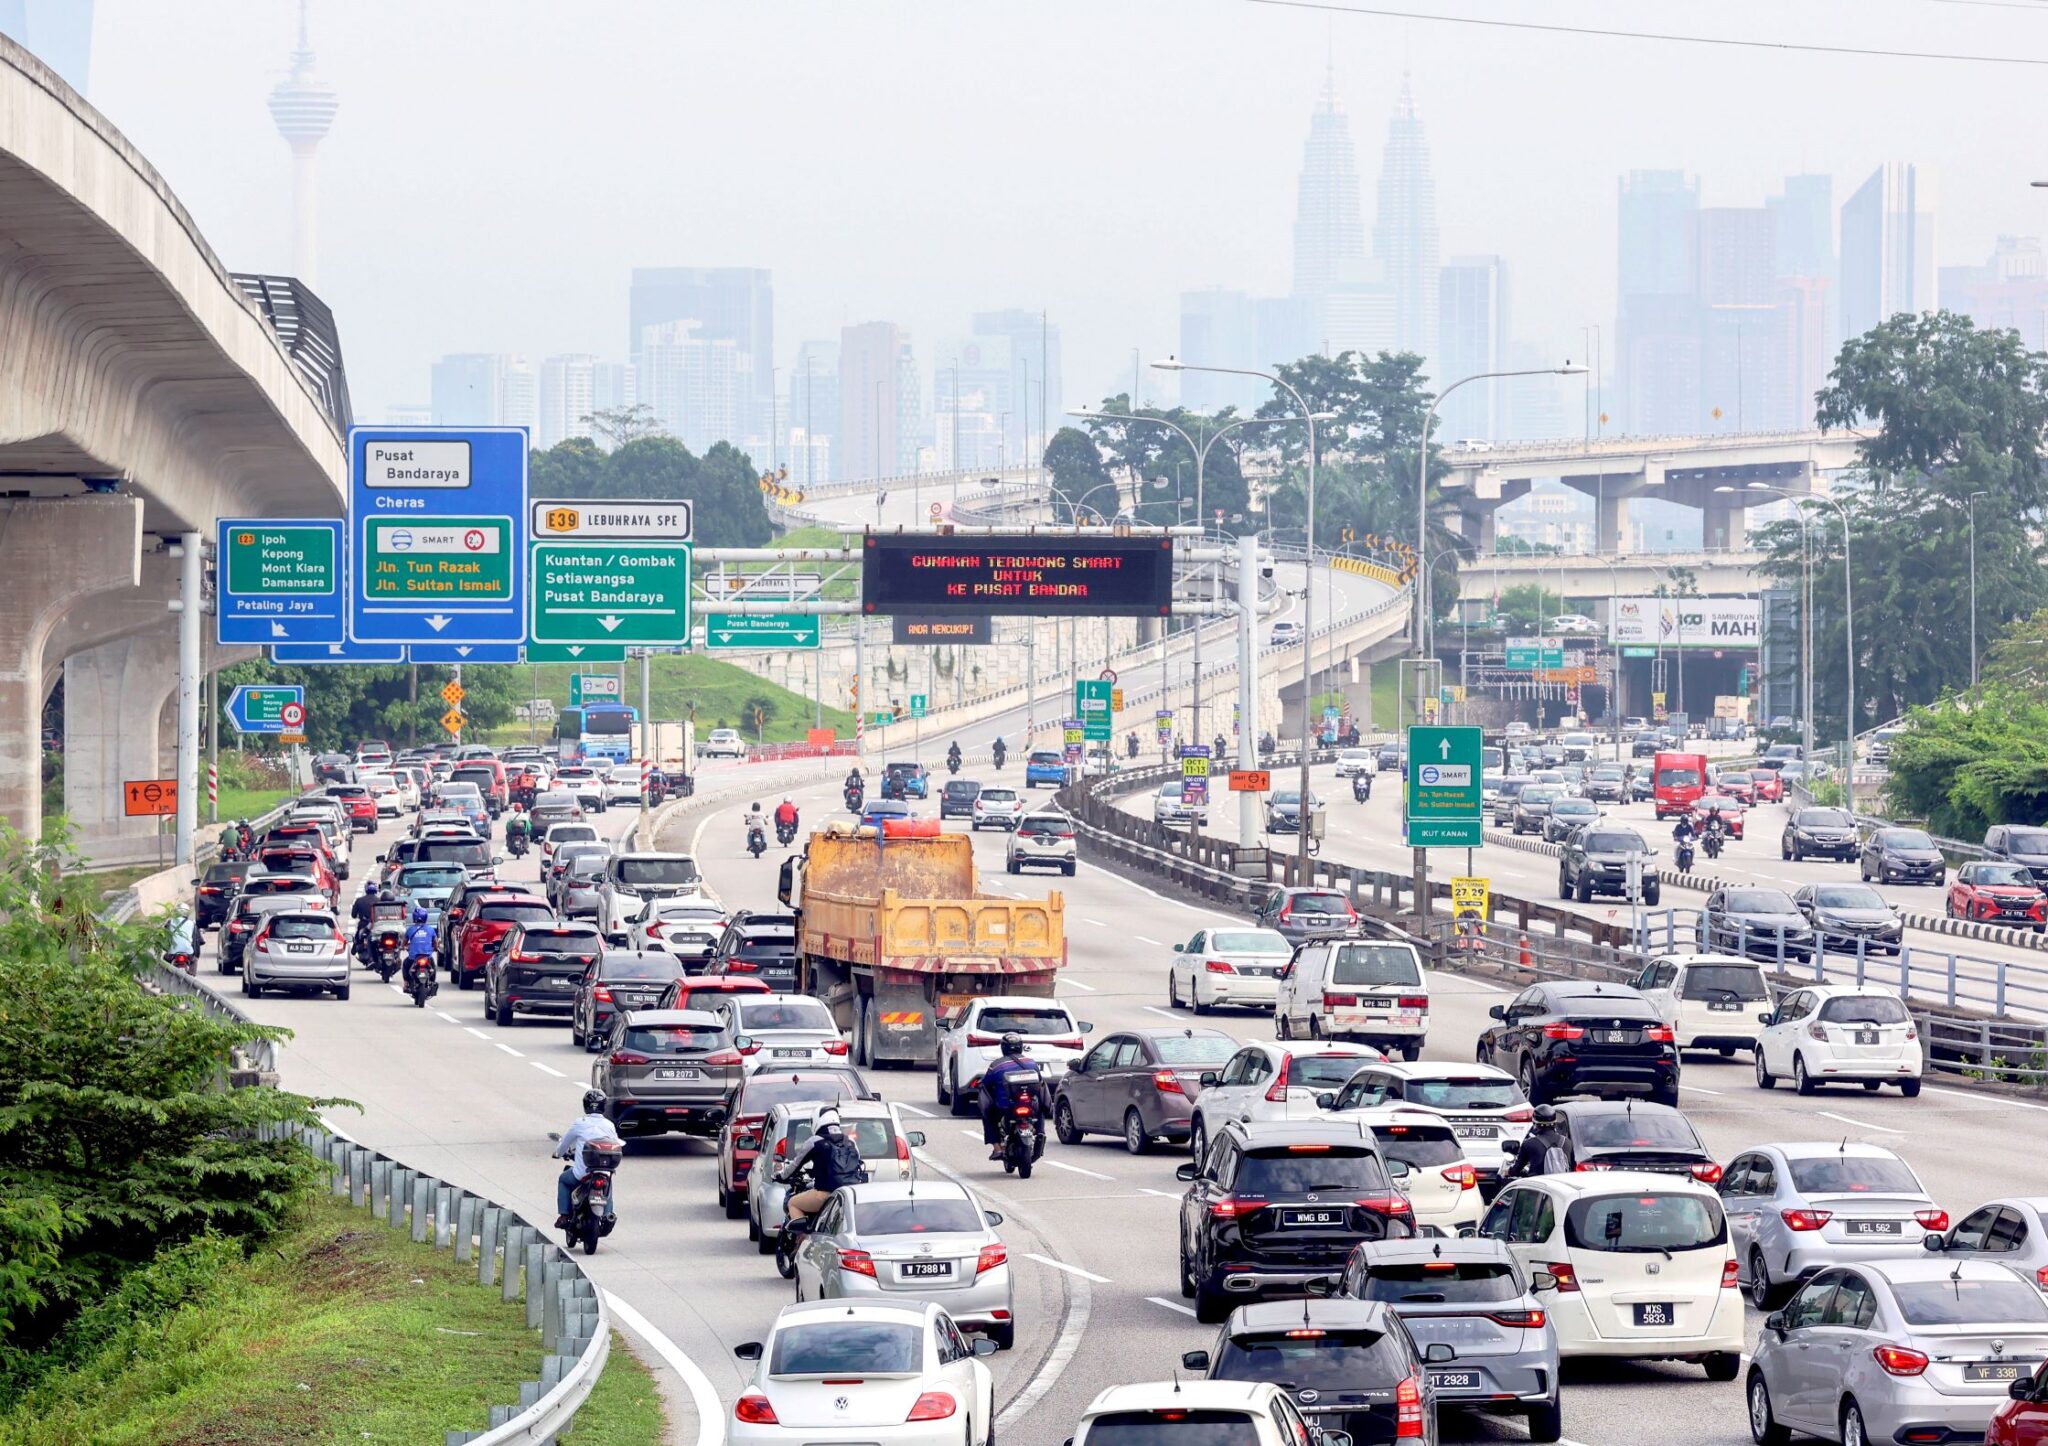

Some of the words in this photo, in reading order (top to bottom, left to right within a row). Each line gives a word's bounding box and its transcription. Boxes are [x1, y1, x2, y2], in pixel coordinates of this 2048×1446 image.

[375, 450, 414, 461] Pusat
[387, 467, 460, 482] Bandaraya
[375, 496, 425, 508] Cheras
[549, 513, 576, 527] E39
[588, 514, 650, 526] LEBUHRAYA
[657, 515, 677, 526] SPE
[262, 534, 286, 545] Ipoh
[422, 536, 455, 544] SMART
[262, 549, 304, 560] Kepong
[545, 554, 602, 566] Kuantan
[619, 555, 676, 567] Gombak
[262, 563, 292, 573] Mont
[296, 563, 325, 573] Kiara
[375, 561, 400, 573] Jln.
[407, 561, 433, 573] Tun
[439, 561, 480, 573] Razak
[912, 555, 980, 568] GUNAKAN
[987, 556, 1066, 568] TEROWONG
[1072, 556, 1123, 569] SMART
[262, 577, 325, 587] Damansara
[545, 572, 635, 588] Setiawangsa
[993, 570, 1043, 582] UNTUK
[375, 579, 400, 591] Jln.
[407, 579, 453, 591] Sultan
[459, 579, 501, 591] Ismail
[947, 583, 967, 595] KE
[974, 584, 1022, 596] PUSAT
[1029, 584, 1089, 596] BANDAR
[545, 590, 584, 602] Pusat
[591, 590, 664, 605] Bandaraya
[237, 600, 284, 612] Petaling
[288, 600, 314, 612] Jaya
[908, 624, 928, 634] ANDA
[932, 624, 974, 635] MENCUKUPI
[1711, 621, 1758, 636] MAH
[287, 710, 299, 719] 40
[1455, 888, 1467, 896] 27
[1471, 888, 1484, 896] 29
[1297, 1213, 1314, 1222] WMG
[1318, 1213, 1330, 1222] 80
[1858, 1223, 1873, 1232] VEL
[1876, 1223, 1891, 1232] 562
[907, 1265, 914, 1275] W
[916, 1264, 938, 1275] 7388
[940, 1263, 947, 1273] M
[1645, 1304, 1662, 1314] WXS
[1643, 1313, 1666, 1323] 5833
[1978, 1368, 1991, 1378] VF
[1996, 1368, 2018, 1378] 3381
[1443, 1374, 1469, 1386] 2928
